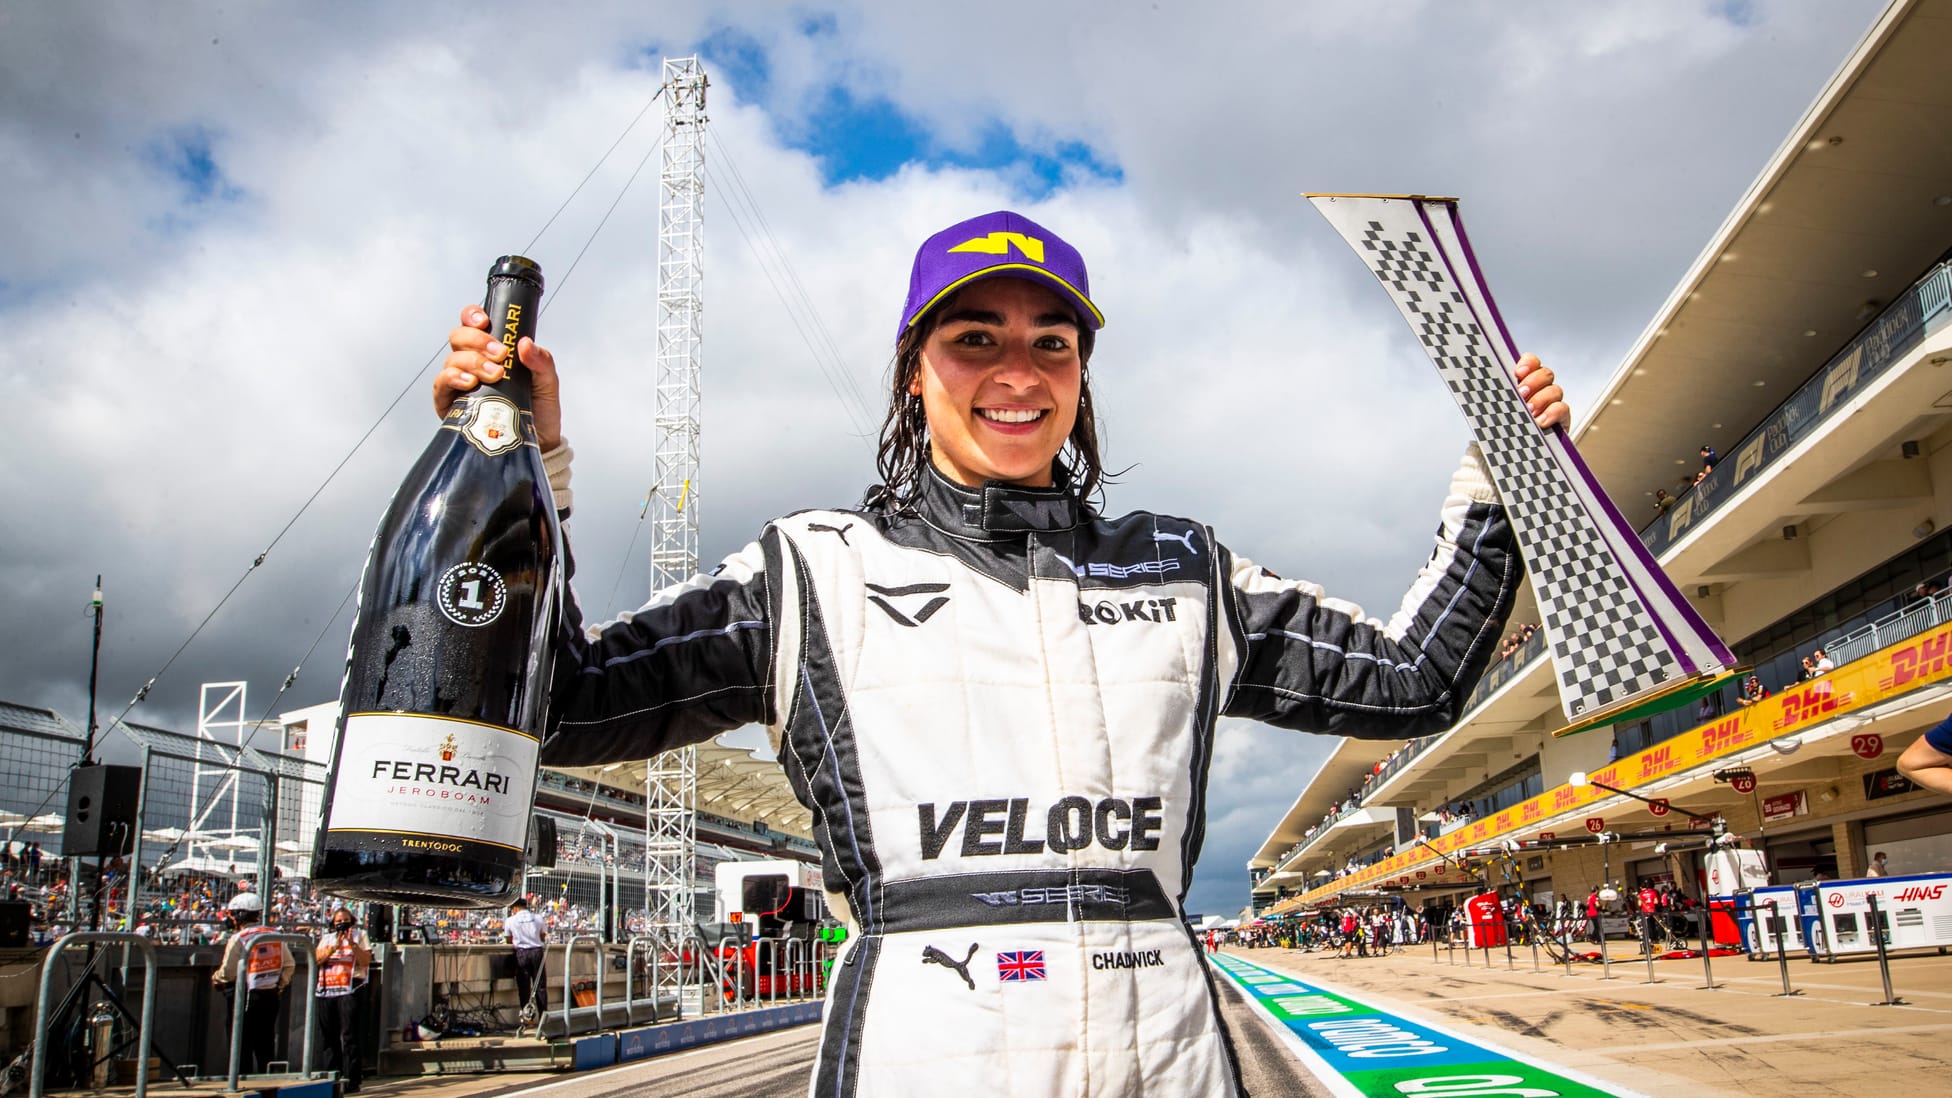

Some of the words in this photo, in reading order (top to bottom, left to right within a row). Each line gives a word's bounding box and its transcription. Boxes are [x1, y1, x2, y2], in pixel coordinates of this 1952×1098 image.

[1088, 558, 1181, 579] SERIES
[458, 580, 484, 610] 1
[1781, 679, 1839, 728] DHL
[1702, 717, 1745, 756] DHL
[1854, 736, 1880, 750] 29
[1641, 745, 1675, 778] DHL
[372, 760, 511, 795] FERRARI
[1593, 768, 1621, 796] DHL
[387, 786, 491, 805] JEROBOAM
[917, 796, 1163, 861] VELOCE
[1589, 820, 1601, 831] 26
[401, 838, 463, 853] TRENTODOC
[1021, 885, 1131, 906] SERIES
[1893, 884, 1948, 902] HAAS
[1092, 949, 1165, 970] CHADWICK
